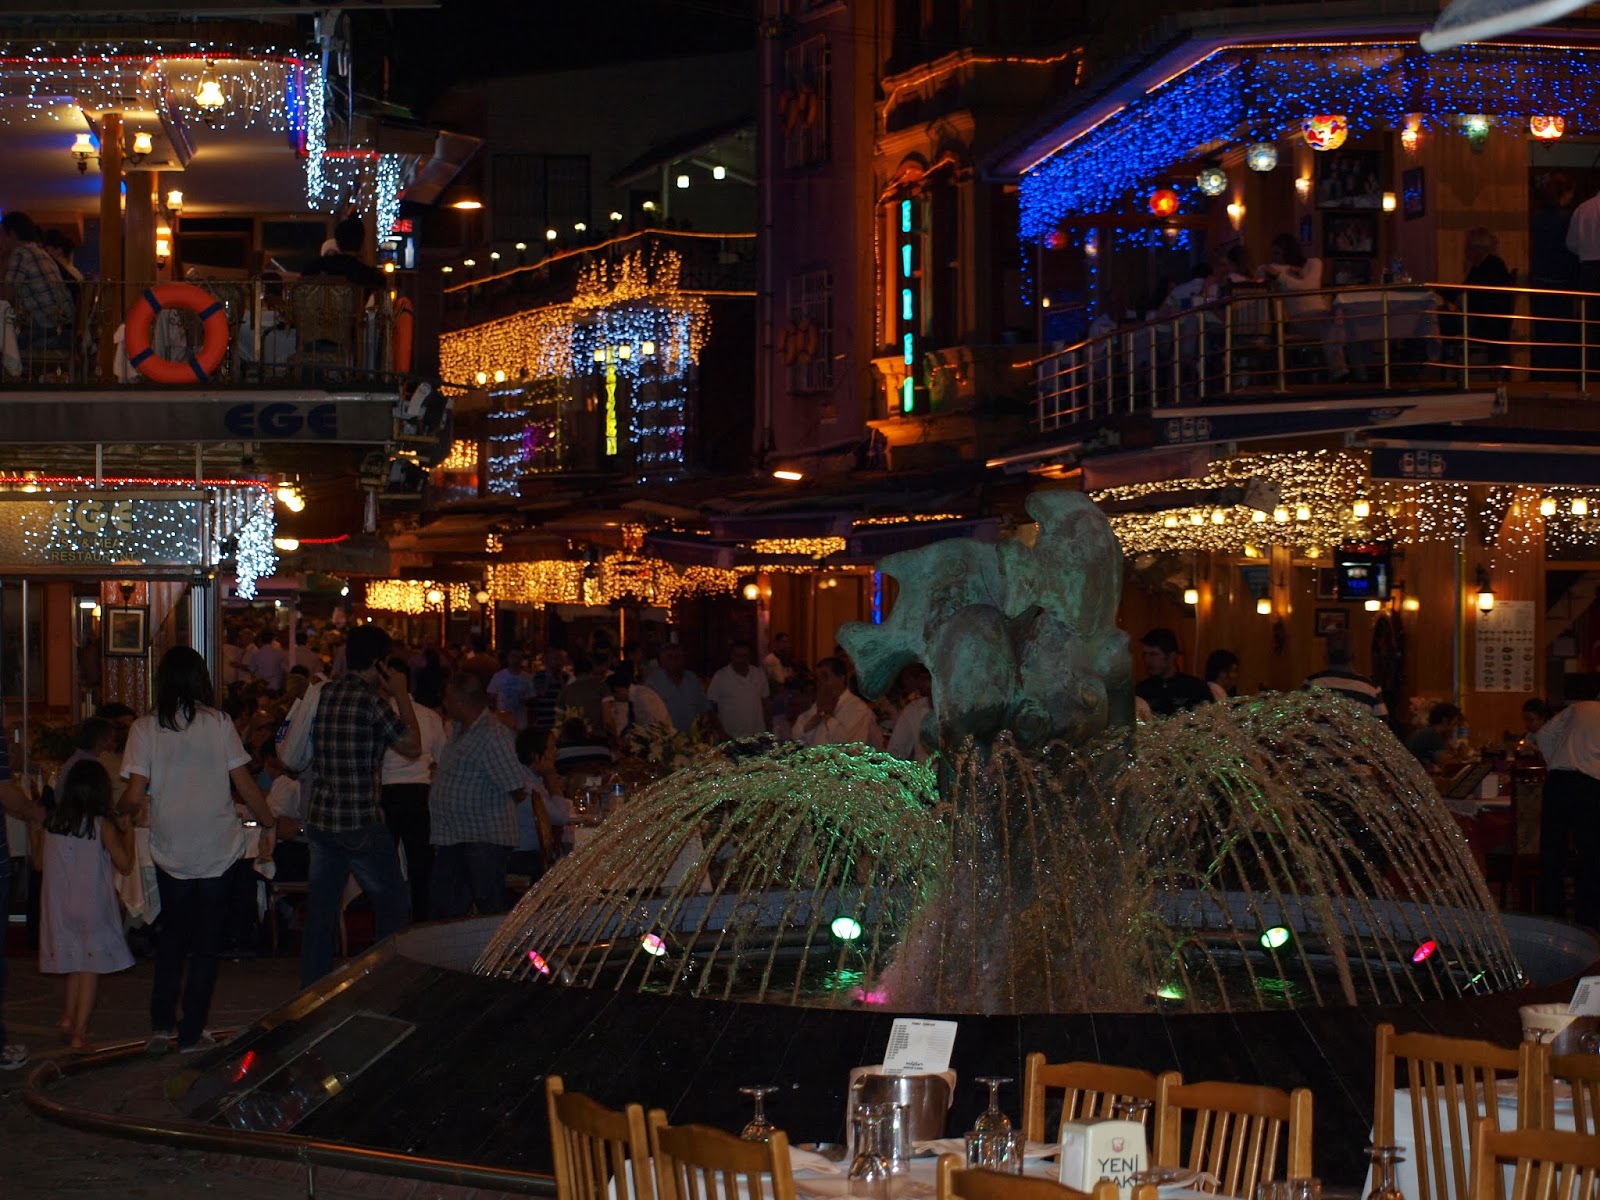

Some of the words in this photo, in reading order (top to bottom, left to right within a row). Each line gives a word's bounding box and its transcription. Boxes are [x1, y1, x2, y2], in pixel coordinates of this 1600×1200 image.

[224, 403, 337, 437] EGE
[52, 500, 133, 533] EGE
[94, 538, 127, 548] MEAT
[51, 551, 136, 561] RESTAURANT
